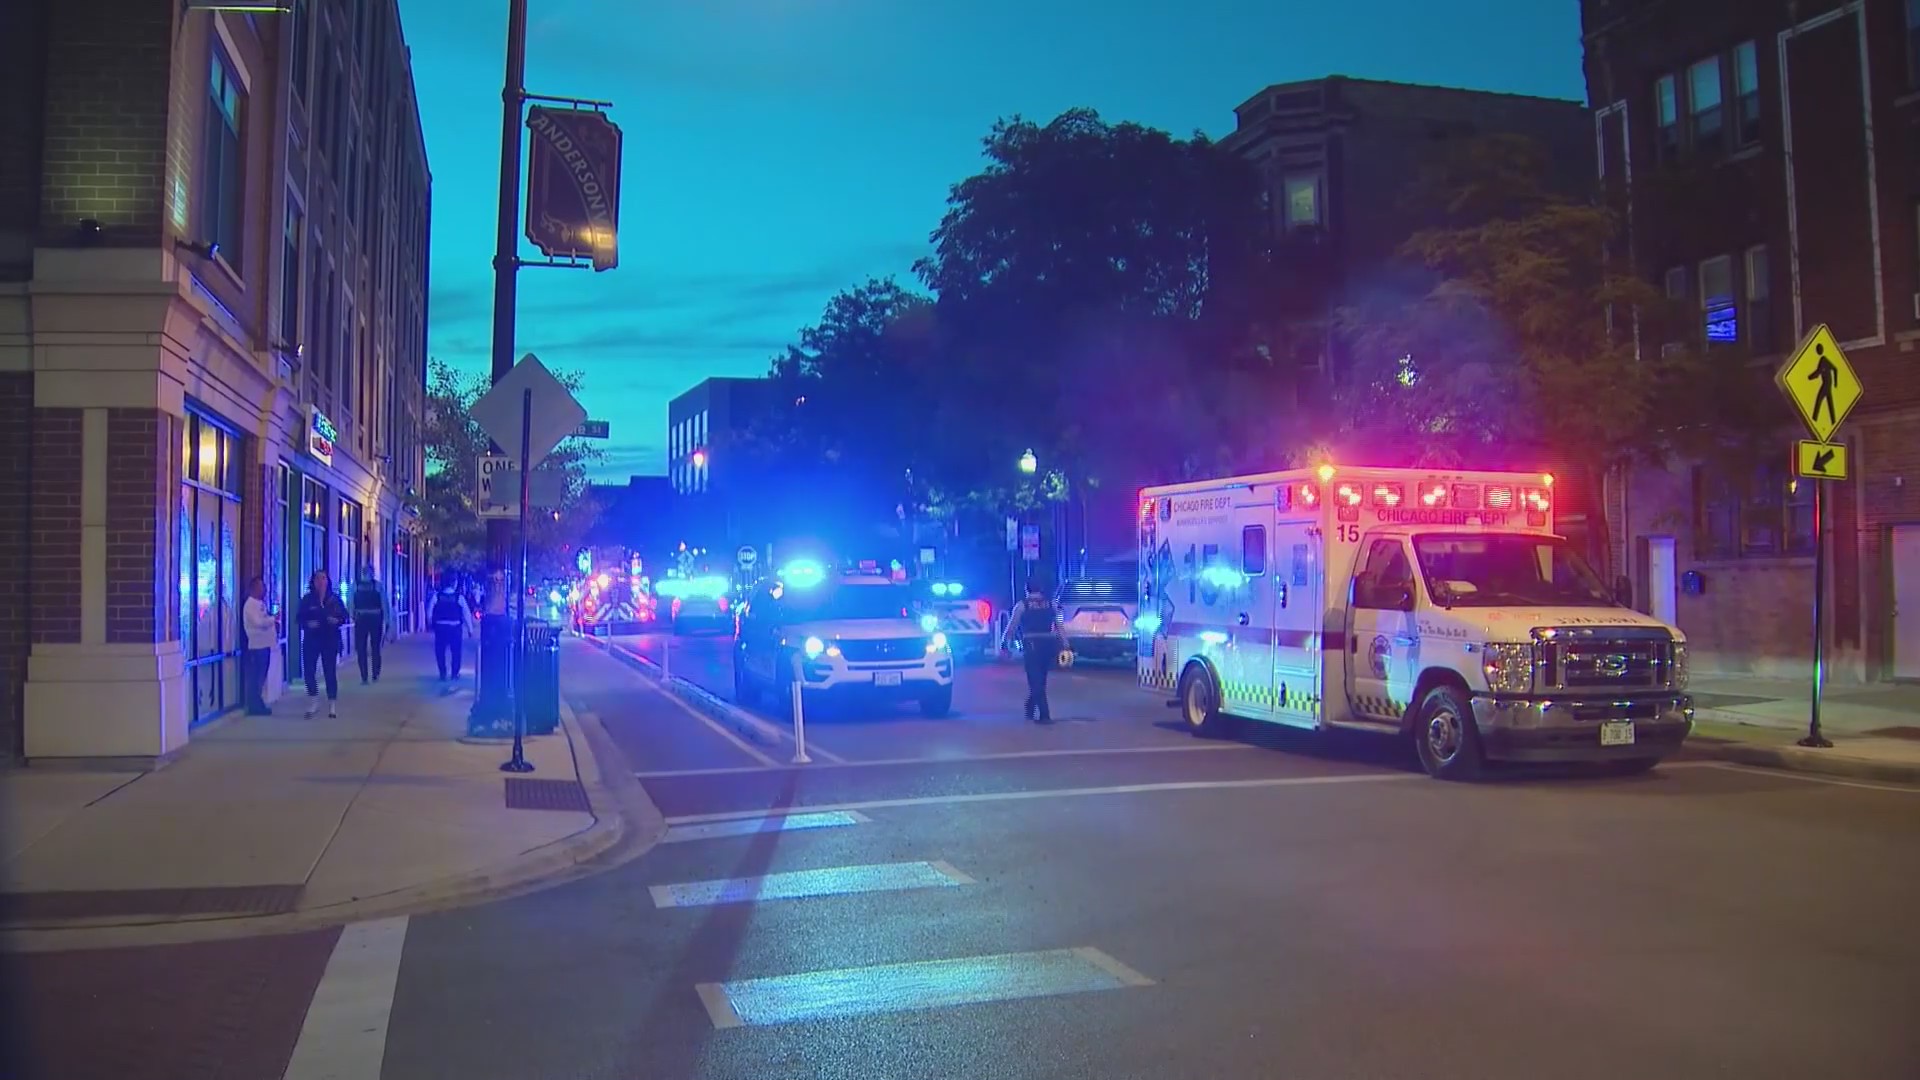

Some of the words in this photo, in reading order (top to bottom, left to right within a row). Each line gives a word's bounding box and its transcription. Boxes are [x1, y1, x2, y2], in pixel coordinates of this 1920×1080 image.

[1173, 500, 1199, 512] CHICAGO
[1200, 499, 1213, 510] FIRE
[1377, 509, 1437, 523] CHICAGO
[1442, 511, 1468, 525] FIRE
[1337, 525, 1359, 542] 15
